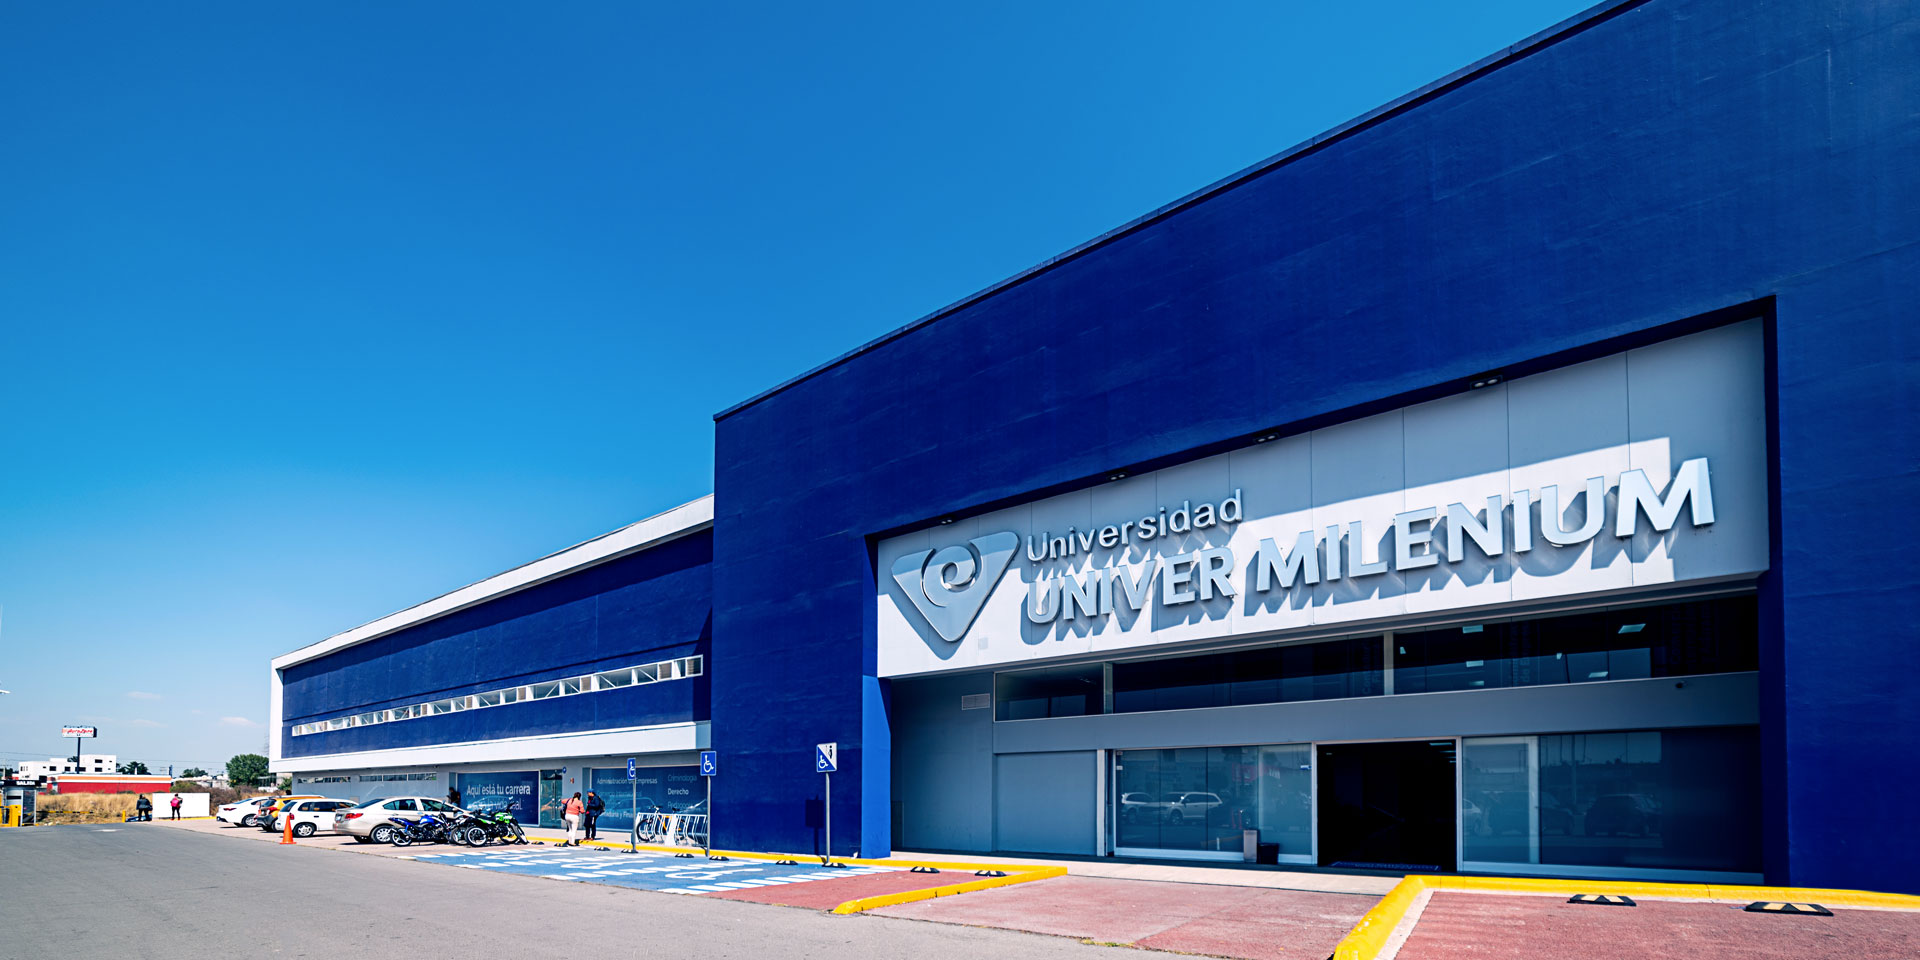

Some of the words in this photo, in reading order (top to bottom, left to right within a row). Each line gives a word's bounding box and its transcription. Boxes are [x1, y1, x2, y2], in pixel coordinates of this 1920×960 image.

[1027, 488, 1243, 562] Universidad
[1027, 547, 1238, 624] UNIVER
[1256, 457, 1715, 592] MILENIUM
[497, 784, 504, 795] tu
[505, 785, 531, 795] carrera
